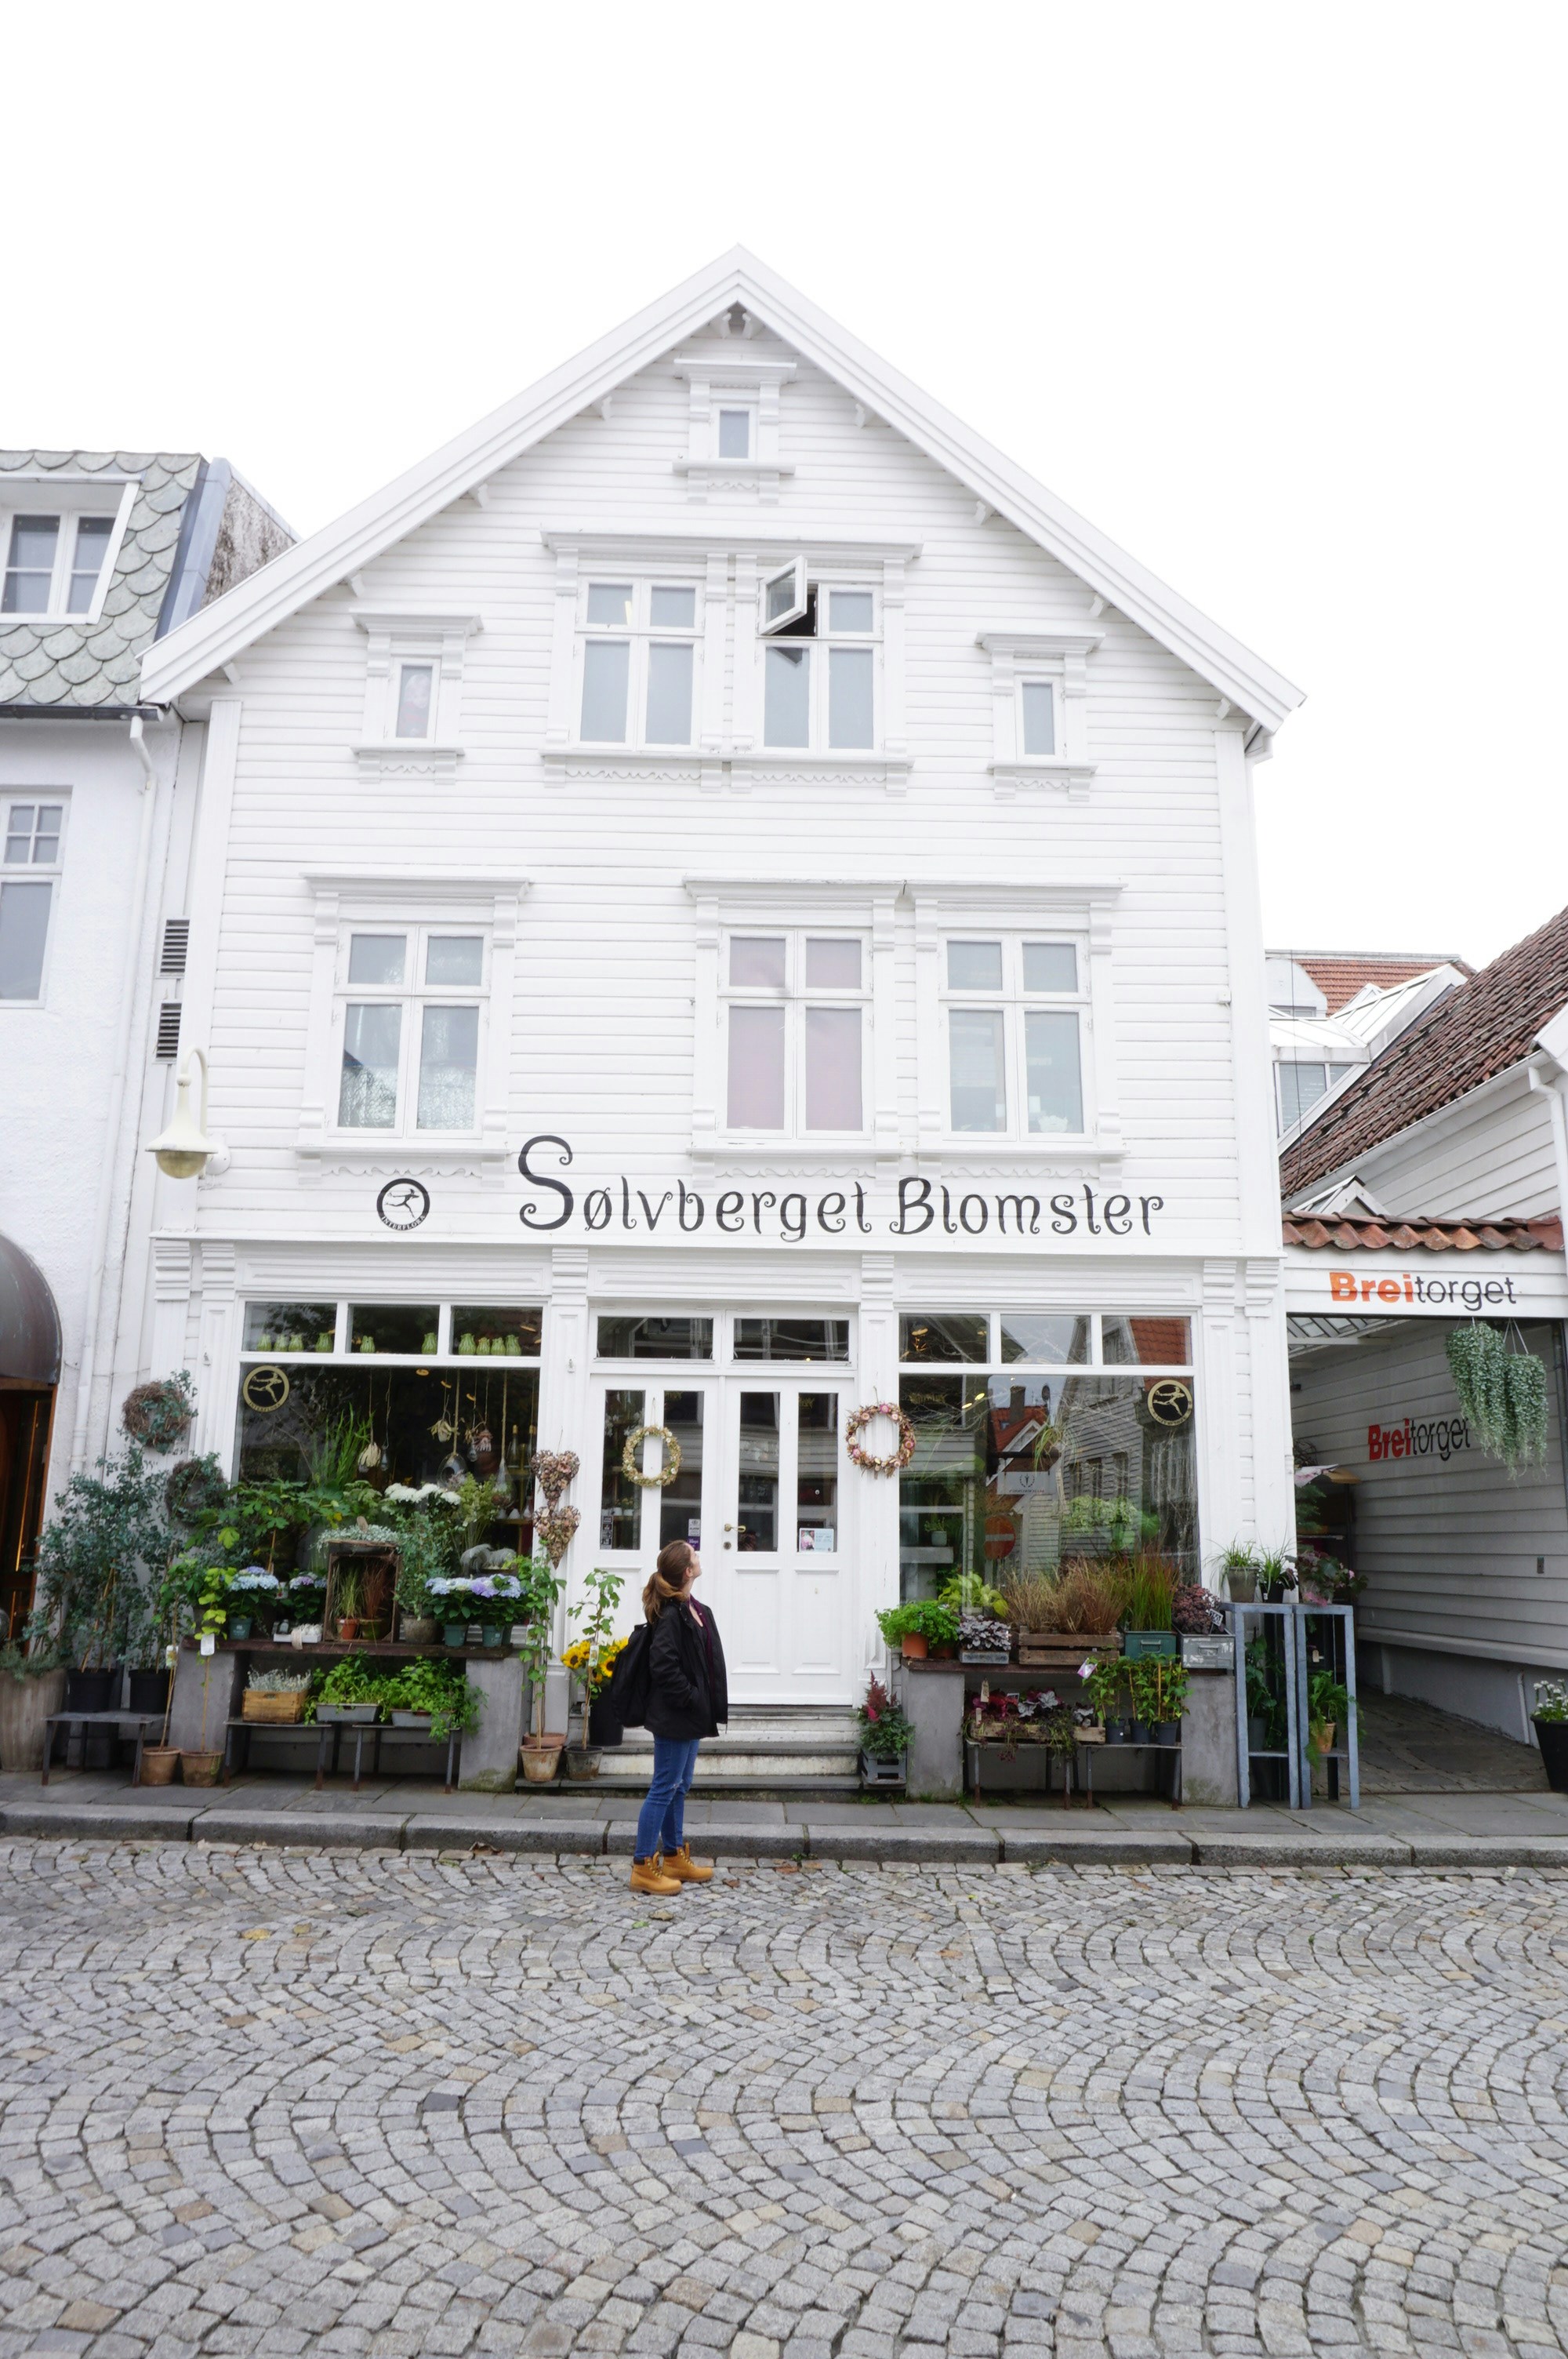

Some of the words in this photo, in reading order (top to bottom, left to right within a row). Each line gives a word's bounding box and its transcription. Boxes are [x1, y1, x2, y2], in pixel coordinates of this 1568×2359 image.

[517, 1135, 872, 1243] Sølvberget
[889, 1176, 1164, 1236] Blomster
[381, 1215, 426, 1231] INTERFLORA
[1329, 1271, 1517, 1311] Breitorget
[1367, 1417, 1471, 1462] Breitorget
